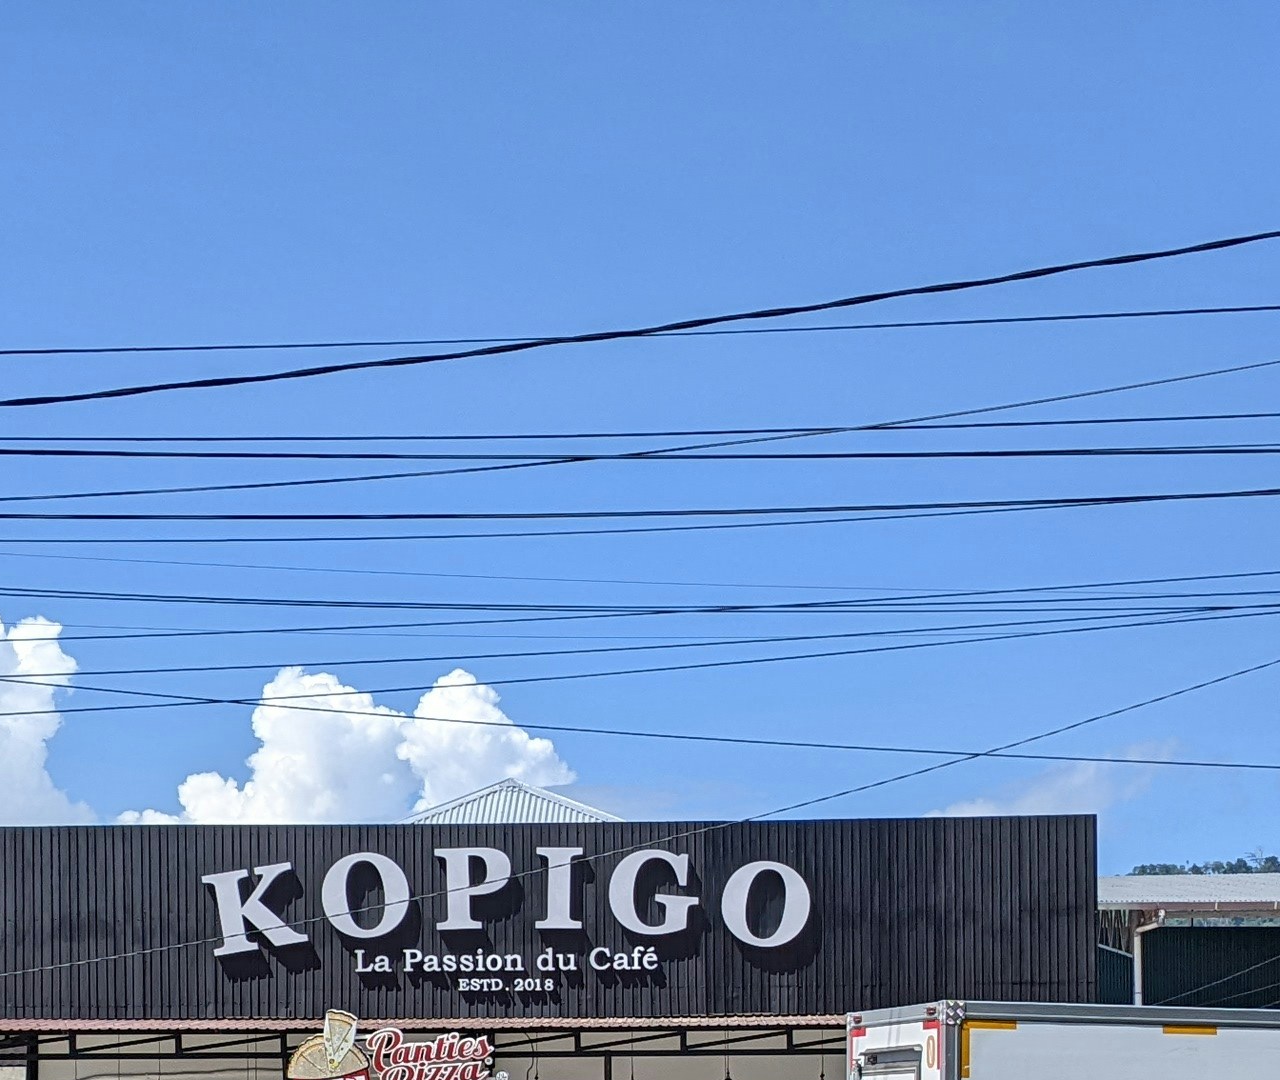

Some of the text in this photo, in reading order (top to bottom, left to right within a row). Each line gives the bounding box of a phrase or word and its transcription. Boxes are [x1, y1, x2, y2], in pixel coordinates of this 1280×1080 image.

[201, 846, 811, 957] KOPIGO
[354, 946, 659, 972] La Passion du Café
[513, 978, 554, 992] 2018
[366, 1027, 495, 1074] Panties
